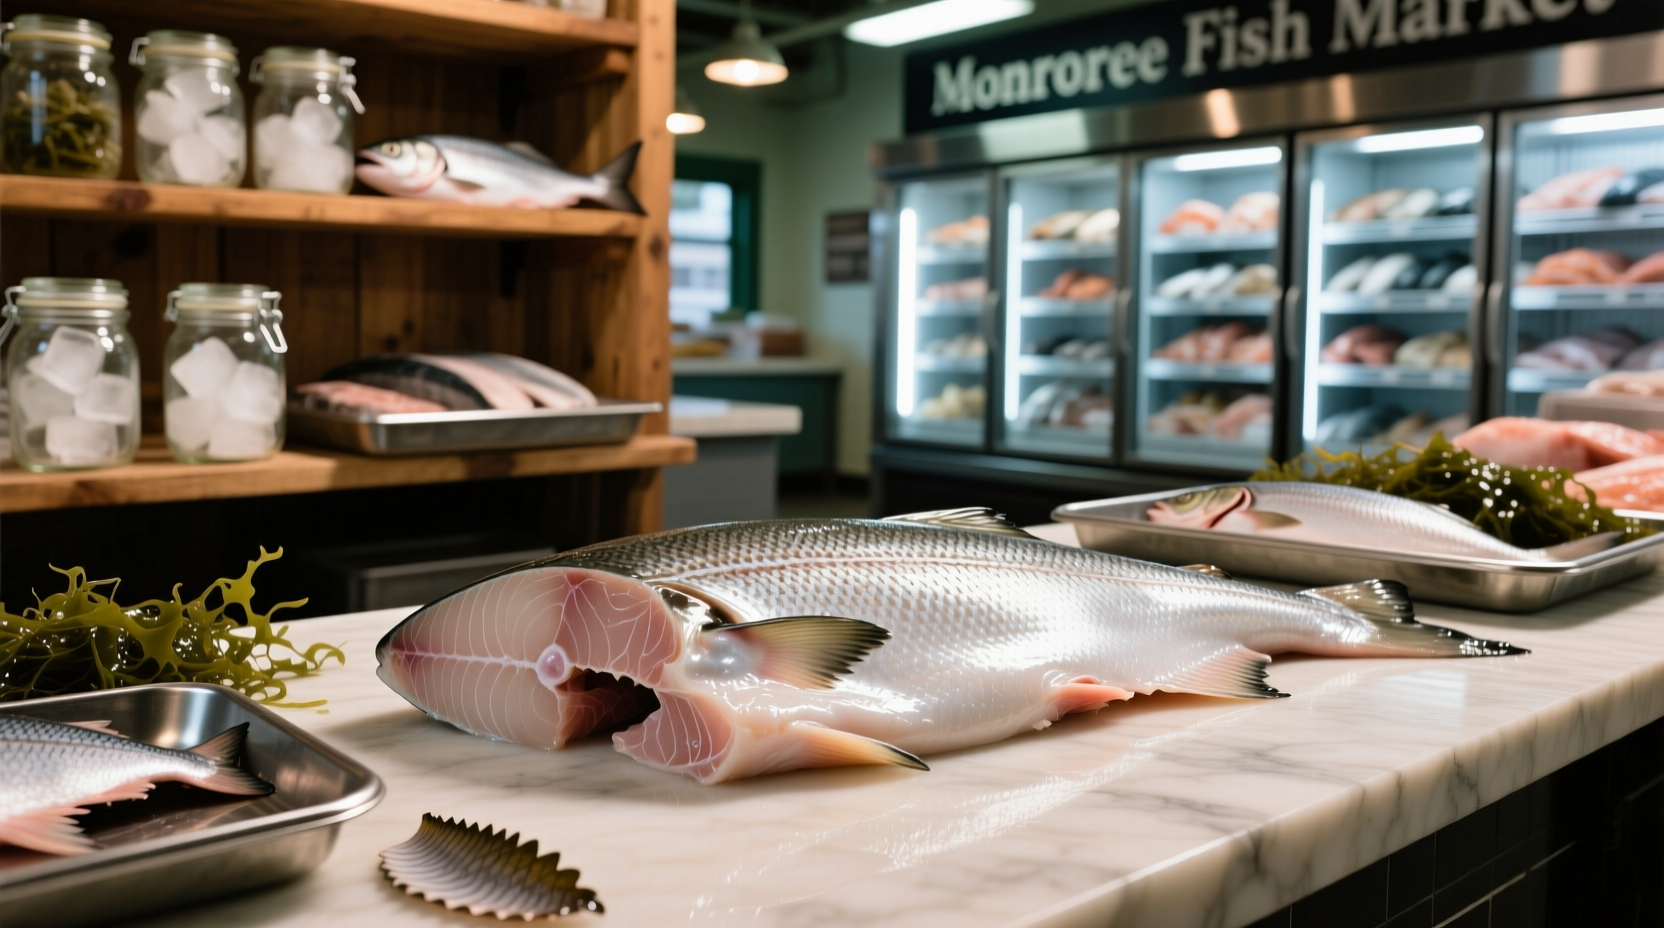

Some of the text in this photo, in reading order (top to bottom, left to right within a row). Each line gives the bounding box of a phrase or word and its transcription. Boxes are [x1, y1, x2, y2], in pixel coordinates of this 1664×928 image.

[931, 0, 1615, 116] Monroree Fish Mar
